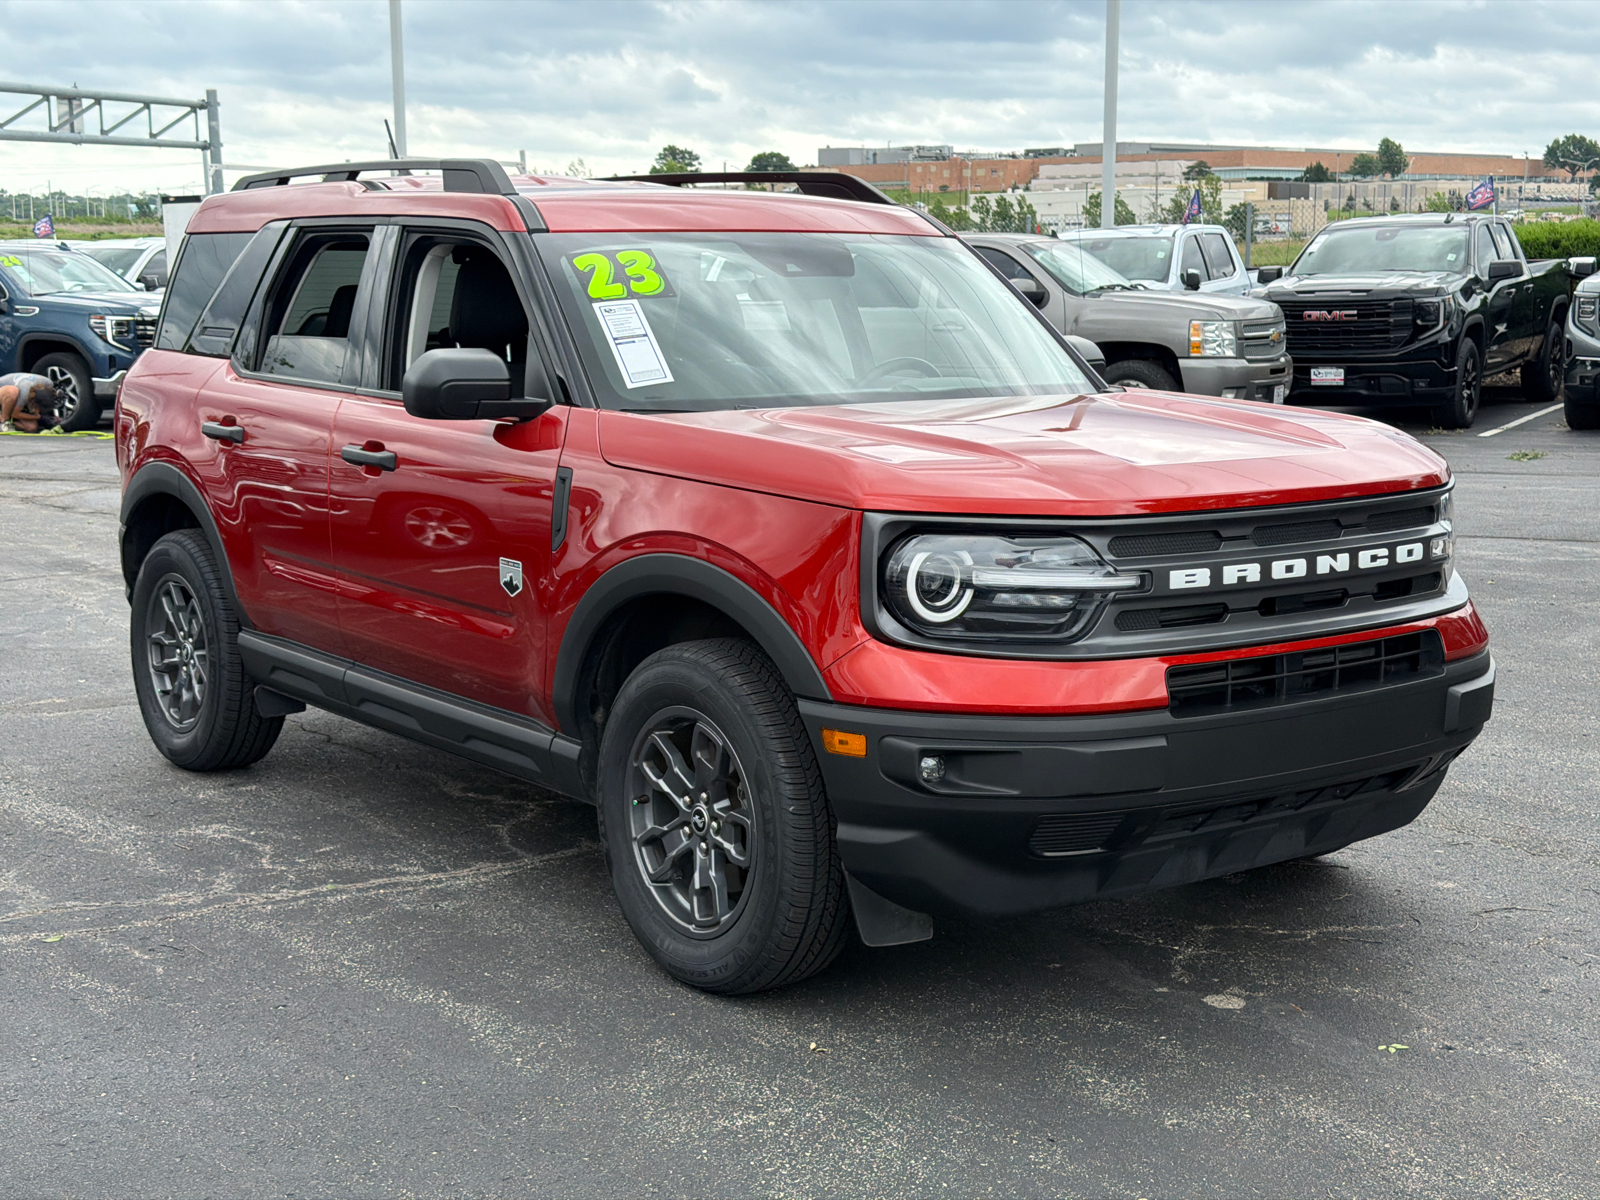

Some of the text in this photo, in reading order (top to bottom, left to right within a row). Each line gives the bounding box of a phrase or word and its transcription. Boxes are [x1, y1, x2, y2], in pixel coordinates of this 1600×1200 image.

[572, 250, 665, 299] 23
[1303, 310, 1358, 321] GMC
[1169, 543, 1424, 589] BRONCO
